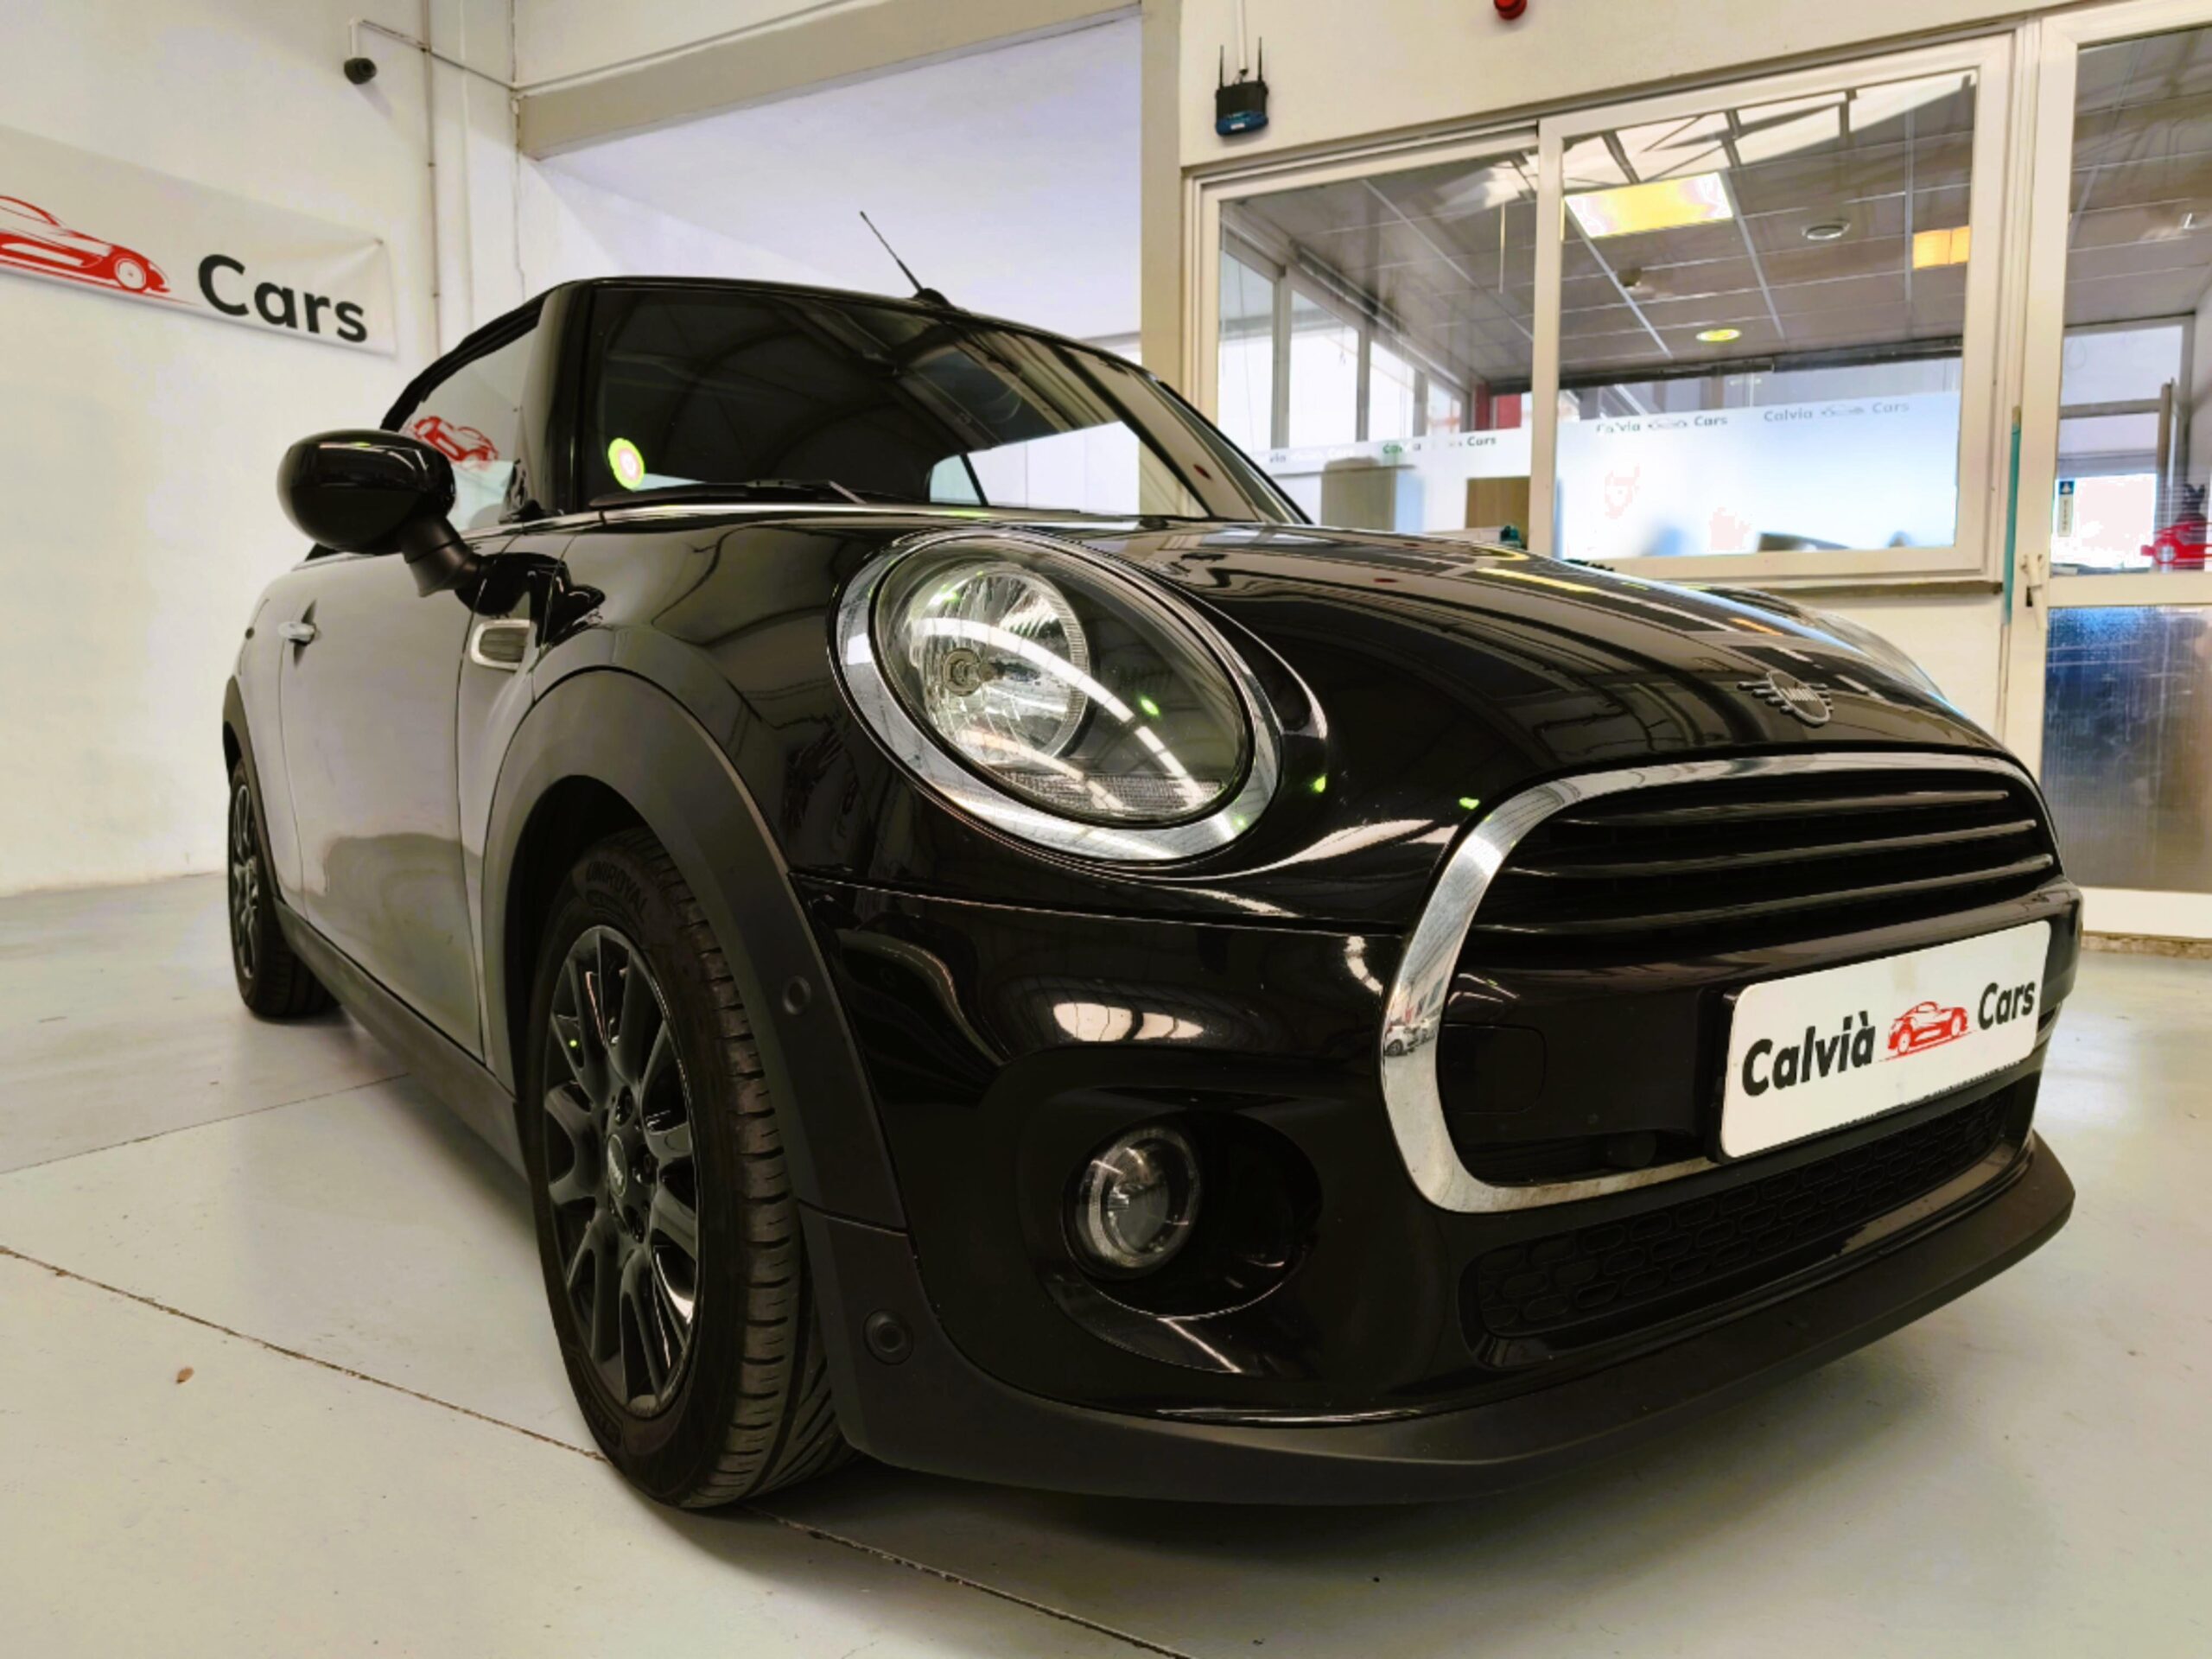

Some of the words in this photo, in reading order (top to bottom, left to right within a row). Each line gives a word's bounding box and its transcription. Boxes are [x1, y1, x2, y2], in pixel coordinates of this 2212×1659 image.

[198, 254, 367, 343] Cars
[1872, 401, 1909, 415] Cars
[1694, 414, 1728, 427] Cars
[1466, 435, 1497, 447] Cars
[1742, 1011, 1876, 1096] Calvià
[1978, 981, 2035, 1031] Cars
